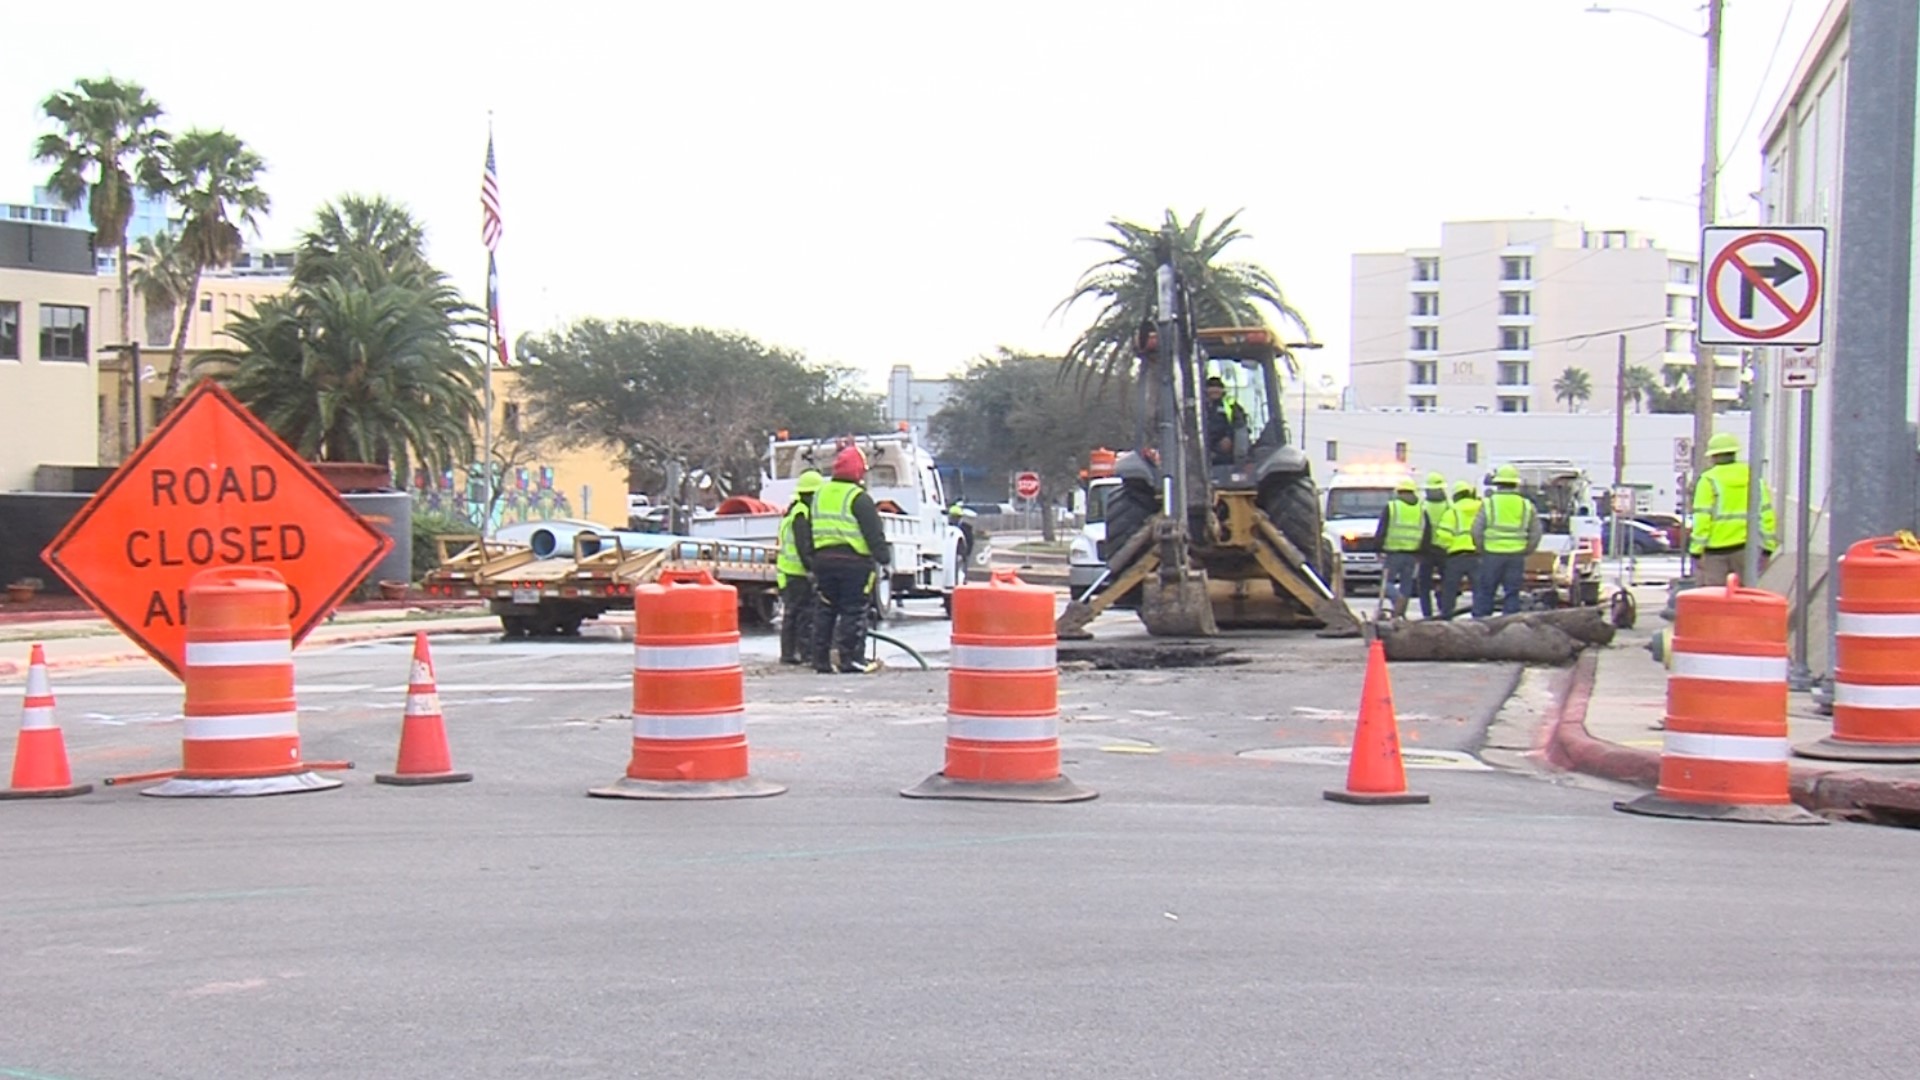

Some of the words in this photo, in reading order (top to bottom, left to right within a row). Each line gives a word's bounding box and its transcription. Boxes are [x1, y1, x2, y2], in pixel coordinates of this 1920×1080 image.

[151, 465, 278, 506] ROAD
[1018, 479, 1038, 490] STOP
[126, 524, 305, 567] CLOSED
